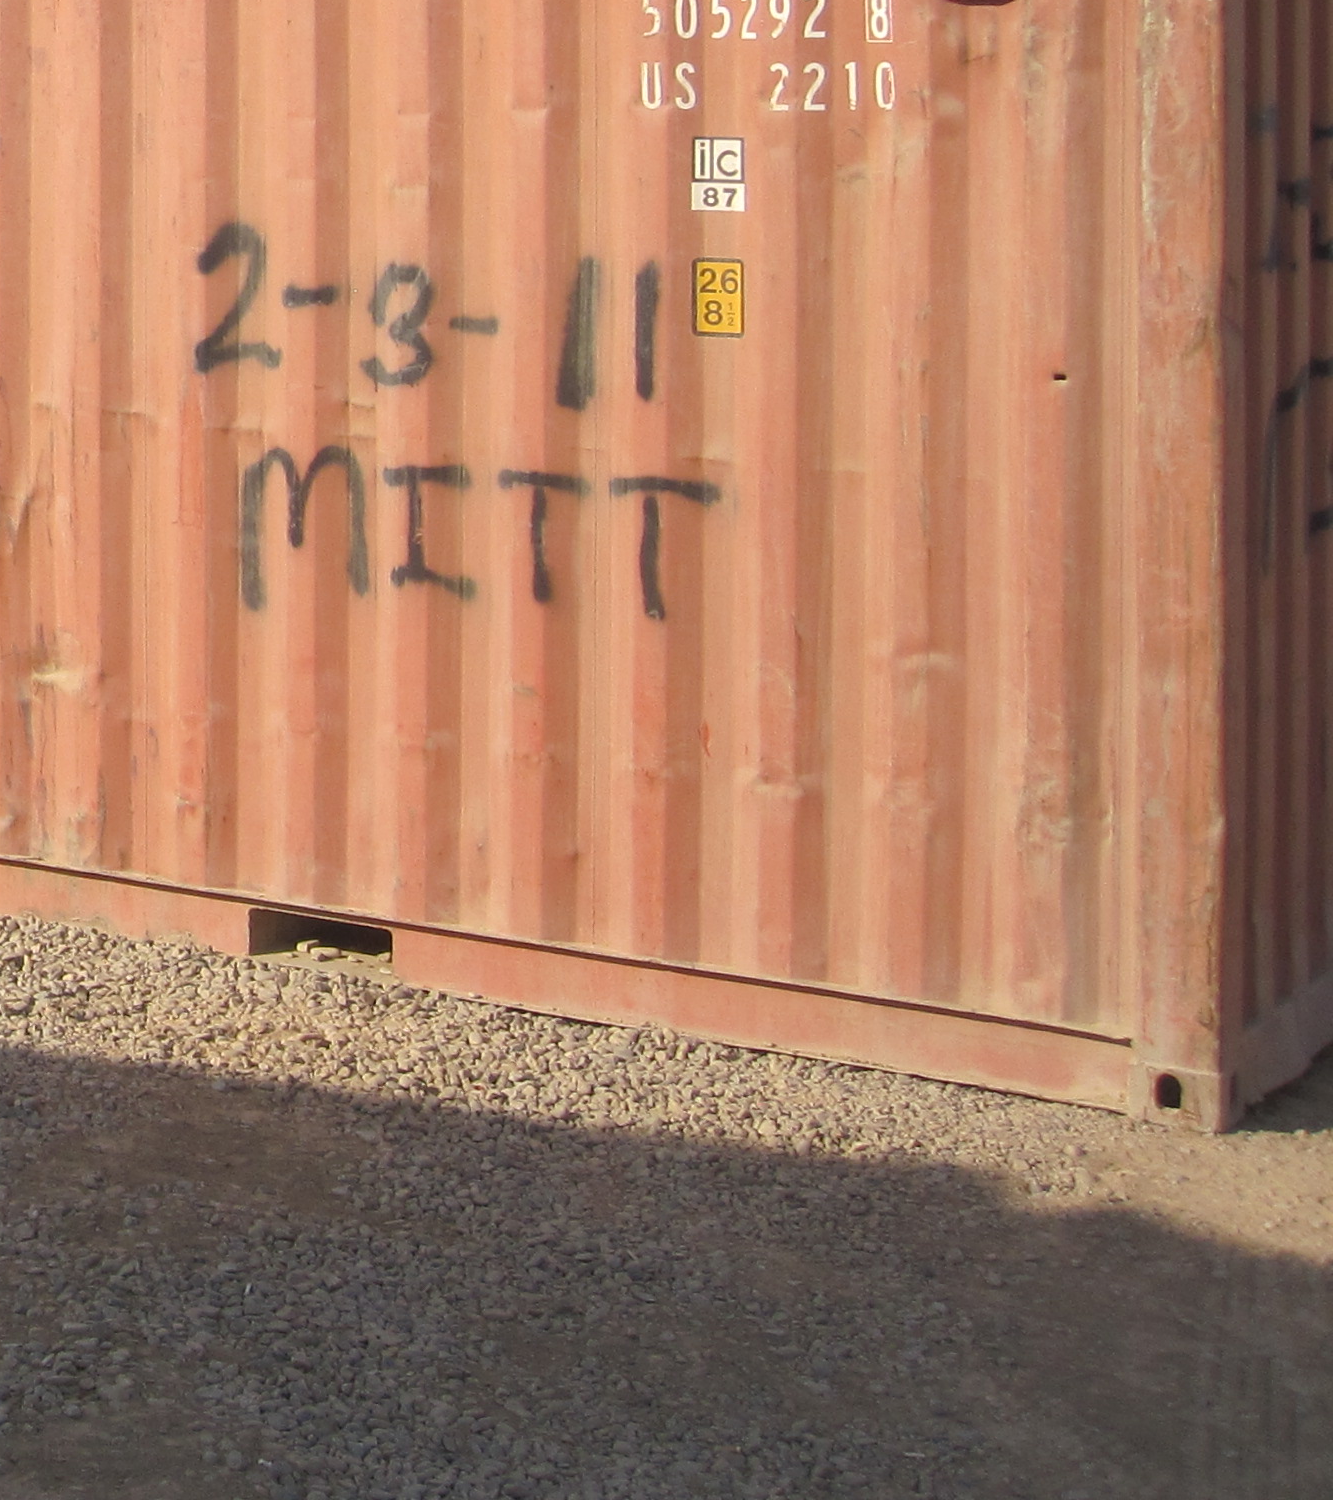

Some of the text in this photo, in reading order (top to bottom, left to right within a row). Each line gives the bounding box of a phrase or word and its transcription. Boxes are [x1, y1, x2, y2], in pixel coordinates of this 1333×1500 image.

[640, 61, 896, 112] US 2210
[702, 187, 738, 208] 87
[699, 267, 739, 295] 2.6
[240, 445, 723, 622] MITT
